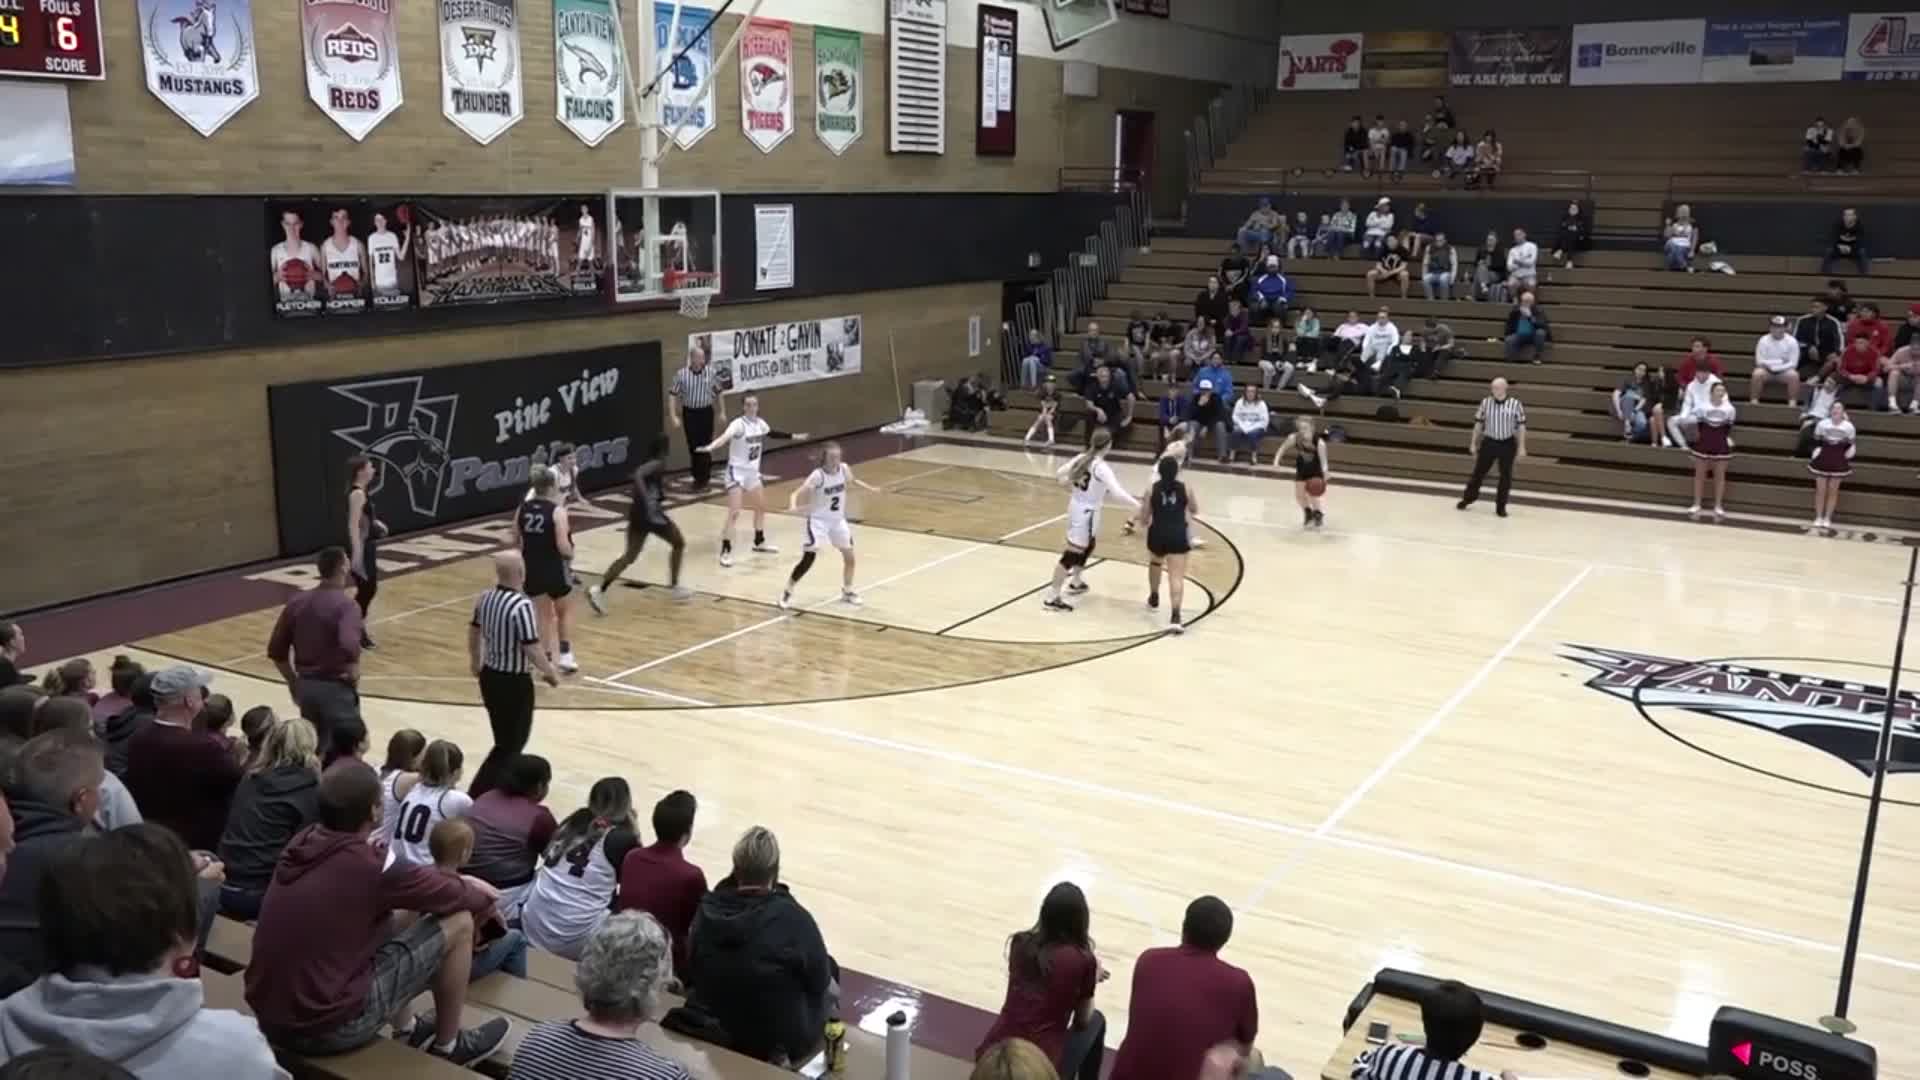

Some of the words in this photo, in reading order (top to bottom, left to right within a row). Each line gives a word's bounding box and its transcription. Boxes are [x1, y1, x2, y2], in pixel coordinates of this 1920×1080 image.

[40, 0, 81, 16] FOULS
[443, 0, 482, 21] DESERT
[57, 17, 78, 50] 6
[327, 40, 377, 59] REDS
[1605, 41, 1697, 57] Bonneville
[45, 56, 87, 73] SCORE
[159, 75, 244, 96] MUSTANGS
[330, 87, 380, 110] REDS
[451, 88, 513, 117] THUNDER
[565, 96, 615, 122] FALCONS
[276, 300, 322, 312] FLETCHER
[326, 299, 366, 310] HOPPER
[734, 326, 777, 359] DONATE
[787, 322, 821, 351] GAVIN
[740, 359, 770, 381] BUCKETS
[494, 396, 552, 443] Pine
[558, 367, 619, 414] View
[830, 496, 840, 511] 2
[524, 513, 545, 534] 22
[394, 800, 431, 845] 10
